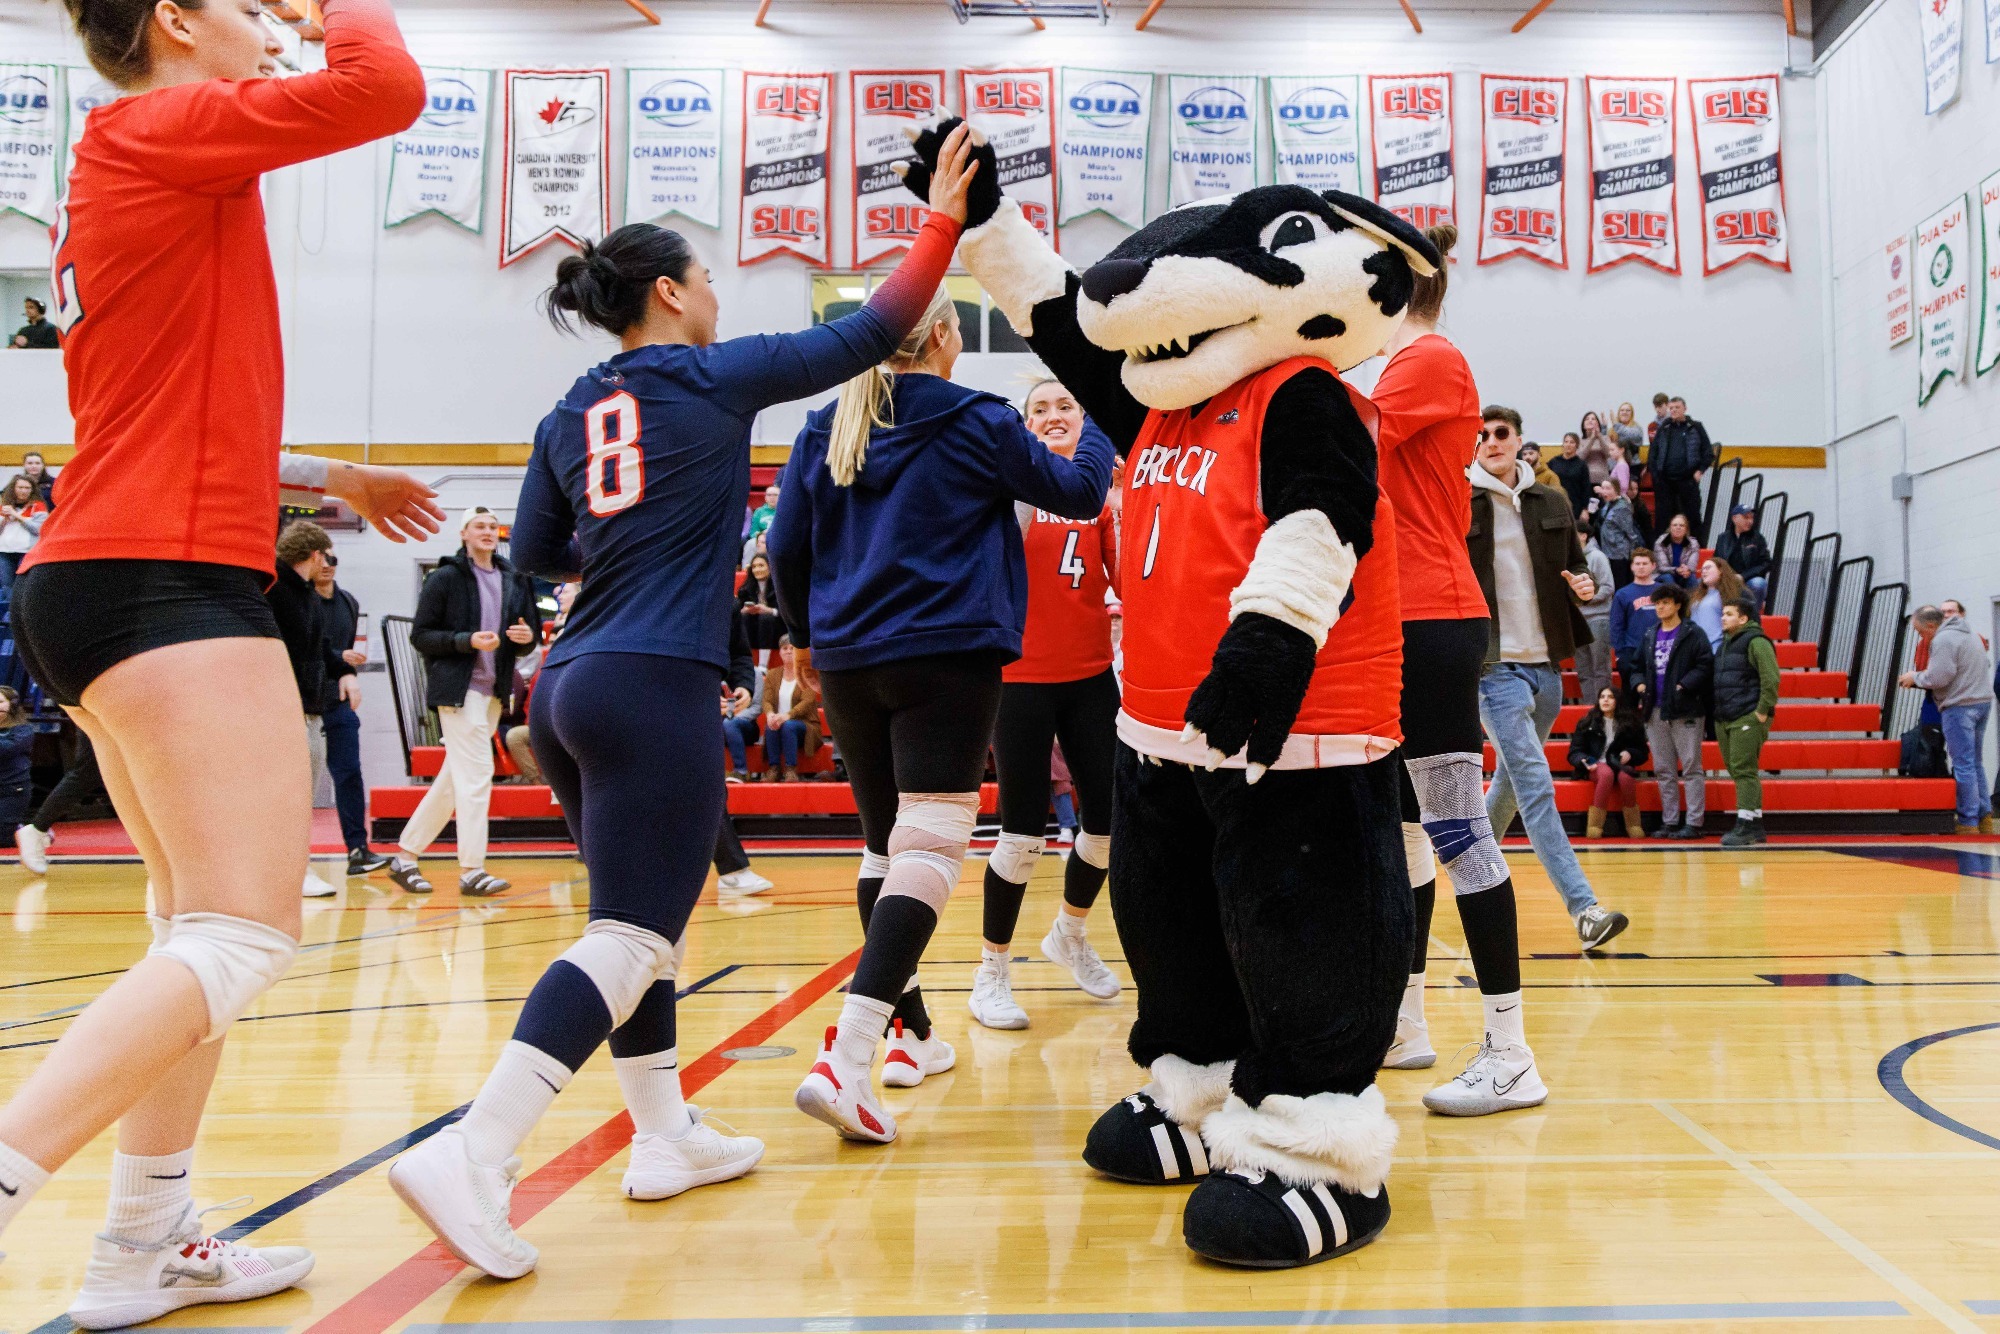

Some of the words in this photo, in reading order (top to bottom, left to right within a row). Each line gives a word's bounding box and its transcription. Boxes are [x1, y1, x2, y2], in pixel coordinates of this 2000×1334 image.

[754, 83, 821, 114] CIS
[863, 80, 935, 112] CIS
[973, 79, 1043, 110] CIS
[1381, 84, 1444, 114] CIS
[1492, 86, 1558, 117] CIS
[1600, 87, 1666, 118] CIS
[1703, 87, 1771, 119] CIS
[432, 96, 476, 112] UA
[638, 97, 712, 113] OUA
[1069, 96, 1141, 115] OUA
[1178, 102, 1248, 120] OUA
[1279, 103, 1350, 120] OUA
[395, 141, 479, 159] CHAMPIONS
[633, 146, 717, 158] CHAMPIONS
[1063, 142, 1144, 160] CHAMPIONS
[1503, 144, 1543, 157] WRESTLING
[1602, 141, 1628, 153] WOMEN
[1634, 133, 1663, 147] FEMMES
[1714, 142, 1730, 154] MEN
[516, 153, 551, 164] CANADIAN
[554, 153, 596, 164] UNIVERSITY
[1173, 150, 1252, 165] CHAMPIONS
[1277, 152, 1356, 165] CHAMPIONS
[1614, 145, 1652, 160] WRESTLING
[1721, 144, 1759, 161] WRESTLING
[528, 167, 549, 178] MEN'S
[553, 167, 585, 178] ROWING
[758, 158, 814, 176] 2012-13
[998, 161, 1047, 184] MPIONS
[1087, 163, 1115, 171] Men's
[1198, 170, 1226, 178] Men's
[1390, 155, 1441, 177] 2014-15
[1497, 160, 1550, 178] 2014-15
[1605, 162, 1660, 182] 2015-16
[1716, 160, 1768, 183] 2015-16
[418, 173, 453, 182] Rowing
[650, 175, 698, 183] Wrestling
[749, 167, 822, 192] CHAMPIONS
[1080, 172, 1122, 181] Baseball
[1194, 180, 1231, 189] Rowing
[1381, 165, 1449, 193] CHAMPIONS
[1489, 170, 1558, 193] CHAMPIONS
[1598, 171, 1667, 197] CHAMPIONS
[1708, 167, 1778, 200] CHAMPIONS
[533, 182, 579, 192] CHAMPIONS
[421, 193, 447, 201] 2012
[652, 194, 697, 203] 2012-13
[1087, 192, 1113, 201] 2014
[543, 205, 571, 217] 2012
[752, 204, 819, 234] SIC
[1491, 206, 1556, 237] SIC
[1602, 209, 1668, 240] SIC
[1713, 208, 1779, 242] SIC
[584, 389, 646, 518] 8
[1131, 443, 1219, 496] BROCK
[1142, 502, 1160, 580] 1
[1058, 529, 1085, 589] 4
